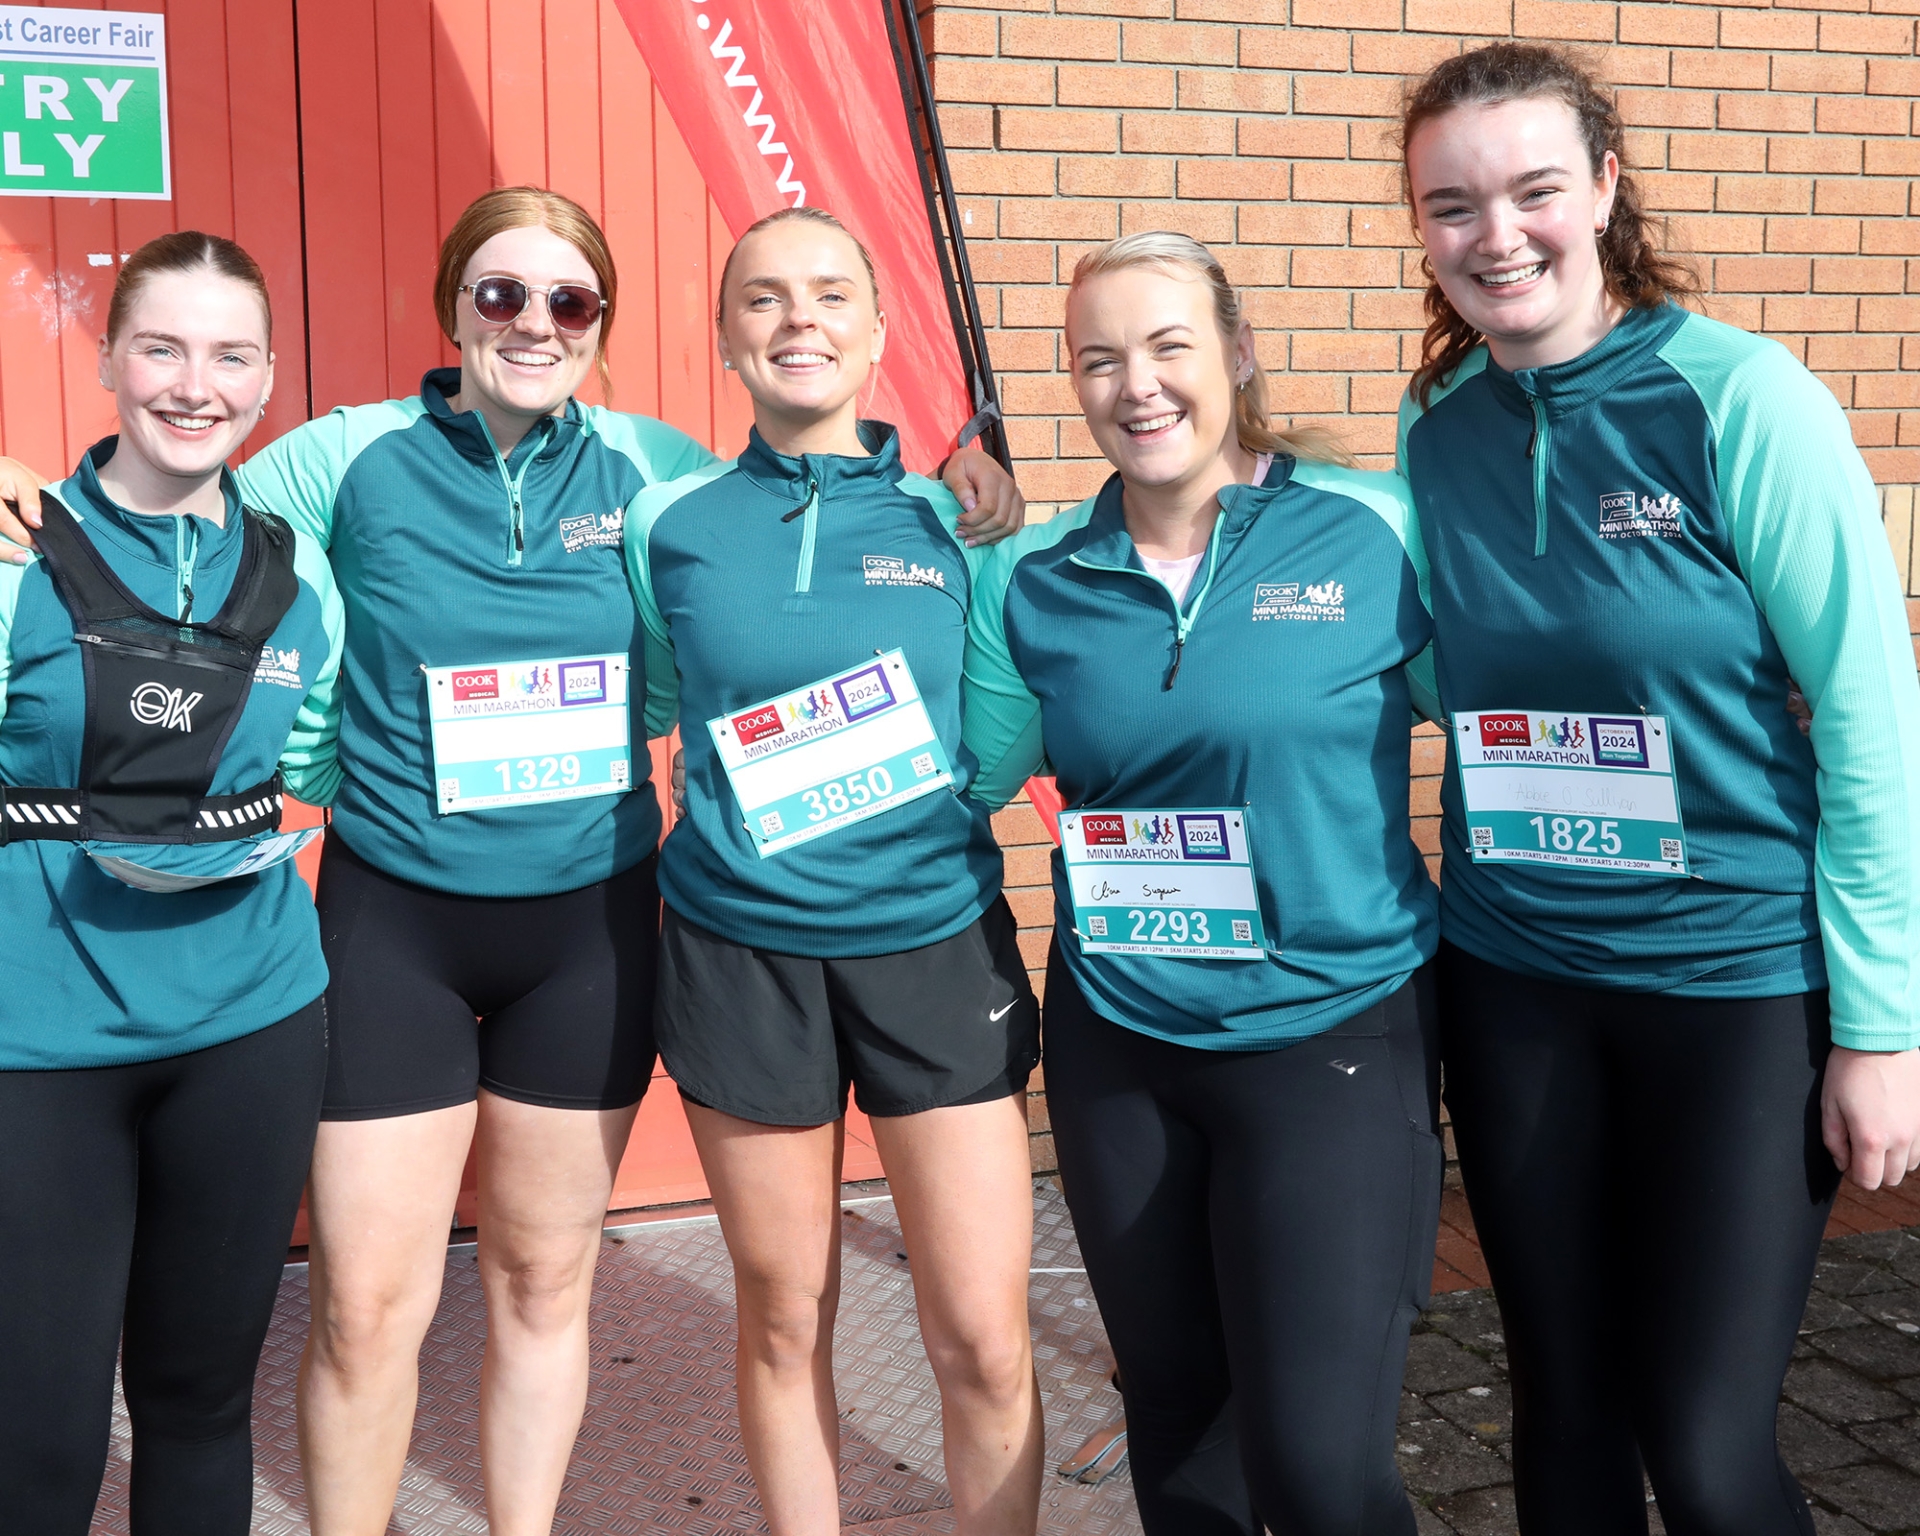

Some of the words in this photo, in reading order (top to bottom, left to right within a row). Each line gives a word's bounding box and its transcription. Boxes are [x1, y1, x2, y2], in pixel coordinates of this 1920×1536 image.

[21, 17, 101, 45] Career
[109, 22, 154, 48] Fair
[0, 74, 135, 122] RY
[1602, 498, 1627, 509] COOK
[562, 518, 591, 531] COOK
[1600, 523, 1622, 532] MINI
[1624, 519, 1680, 531] MARATHON
[564, 536, 584, 549] MINI
[585, 531, 622, 541] MARATH
[1620, 530, 1659, 538] OCTOBER
[867, 559, 900, 569] COOK
[865, 571, 889, 580] MINI
[1260, 588, 1294, 596] COOK
[1253, 607, 1278, 615] MINI
[1280, 604, 1345, 615] MARATHON
[455, 675, 495, 687] COOK
[568, 676, 597, 689] 2024
[848, 683, 880, 703] 2024
[453, 704, 480, 715] MINI
[484, 697, 556, 712] MARATHON
[738, 711, 776, 732] COOK
[1484, 720, 1525, 732] COOK
[744, 741, 772, 760] MINI
[772, 717, 843, 750] MARATHON
[1602, 736, 1636, 748] 2024
[1483, 750, 1513, 761] MINI
[1516, 750, 1590, 764] MARATHON
[494, 754, 581, 792] 1329
[801, 766, 893, 822] 3850
[1086, 820, 1121, 831] COOK
[1189, 831, 1219, 842] 2024
[1530, 815, 1622, 855] 1825
[1087, 849, 1112, 859] MINI
[1114, 849, 1179, 860] MARATHON
[1522, 851, 1542, 859] STARTS
[1128, 909, 1210, 944] 2293
